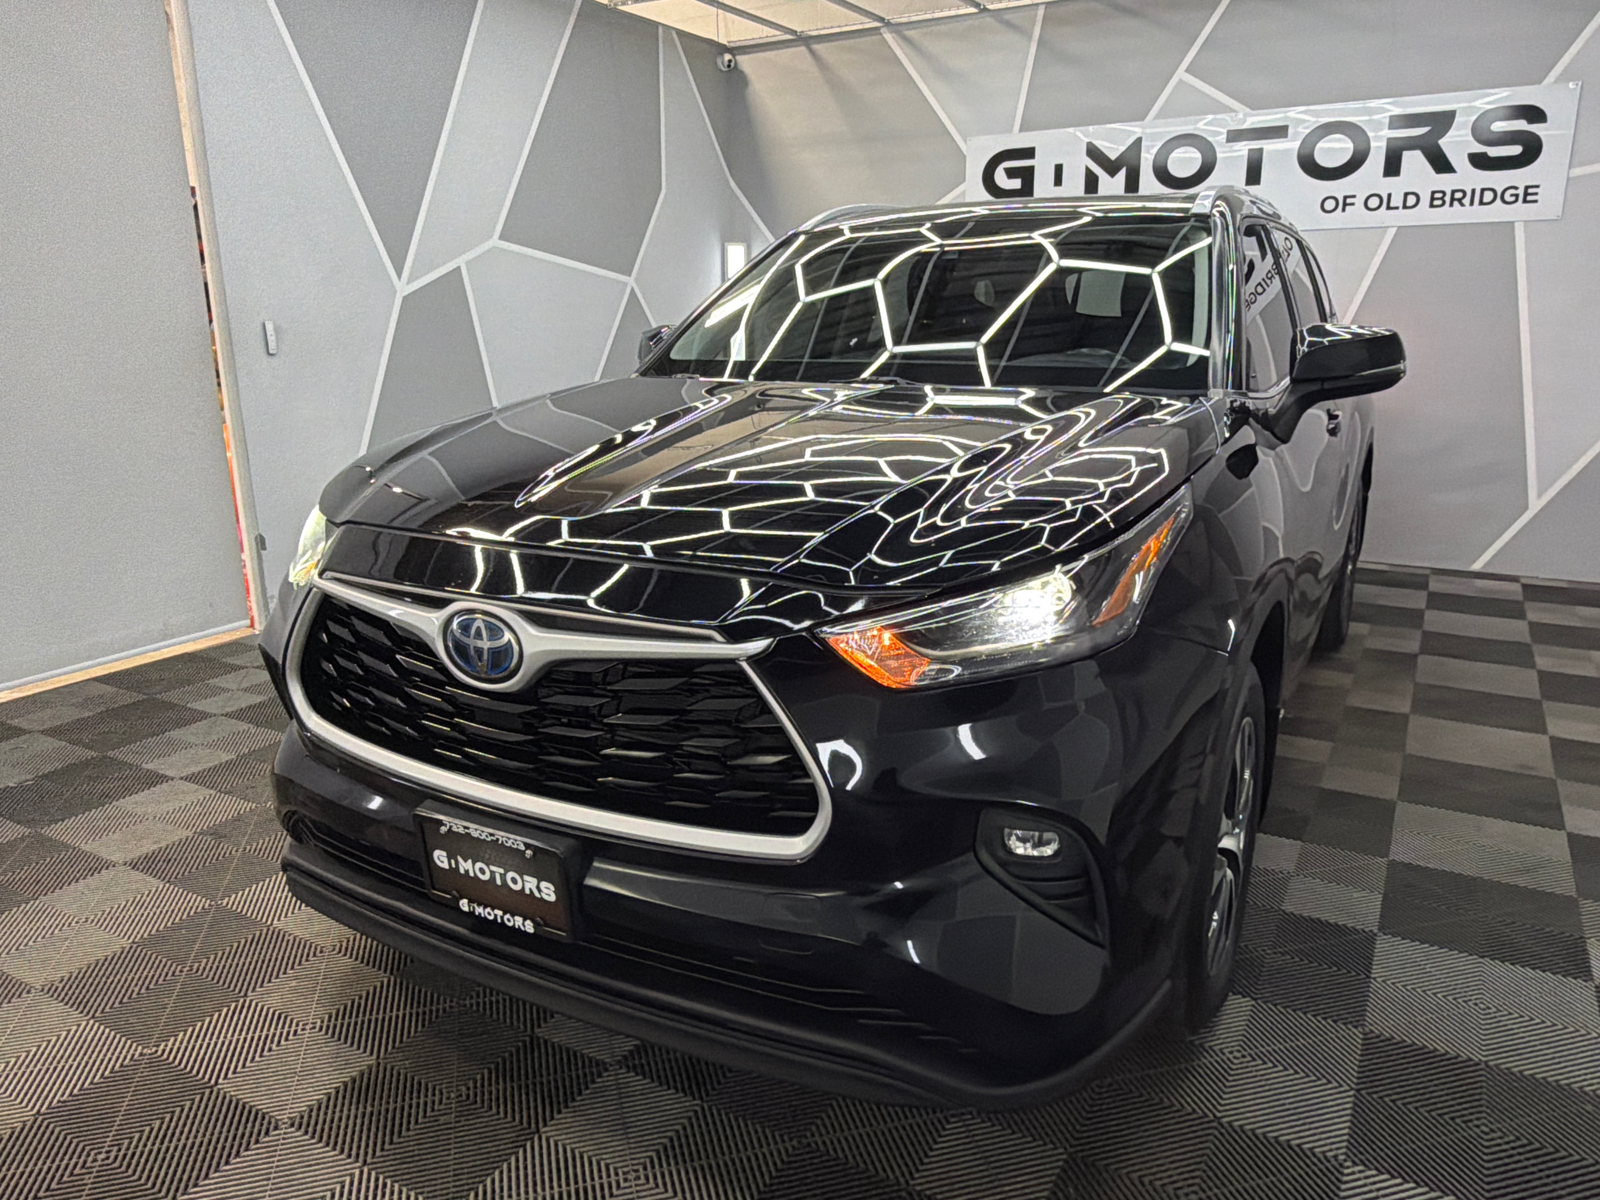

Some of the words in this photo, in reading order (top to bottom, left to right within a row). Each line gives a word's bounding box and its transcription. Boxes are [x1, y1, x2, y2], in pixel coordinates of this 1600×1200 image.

[1319, 194, 1357, 214] OF
[1363, 191, 1421, 212] OLD
[1428, 184, 1541, 209] BRIDGE
